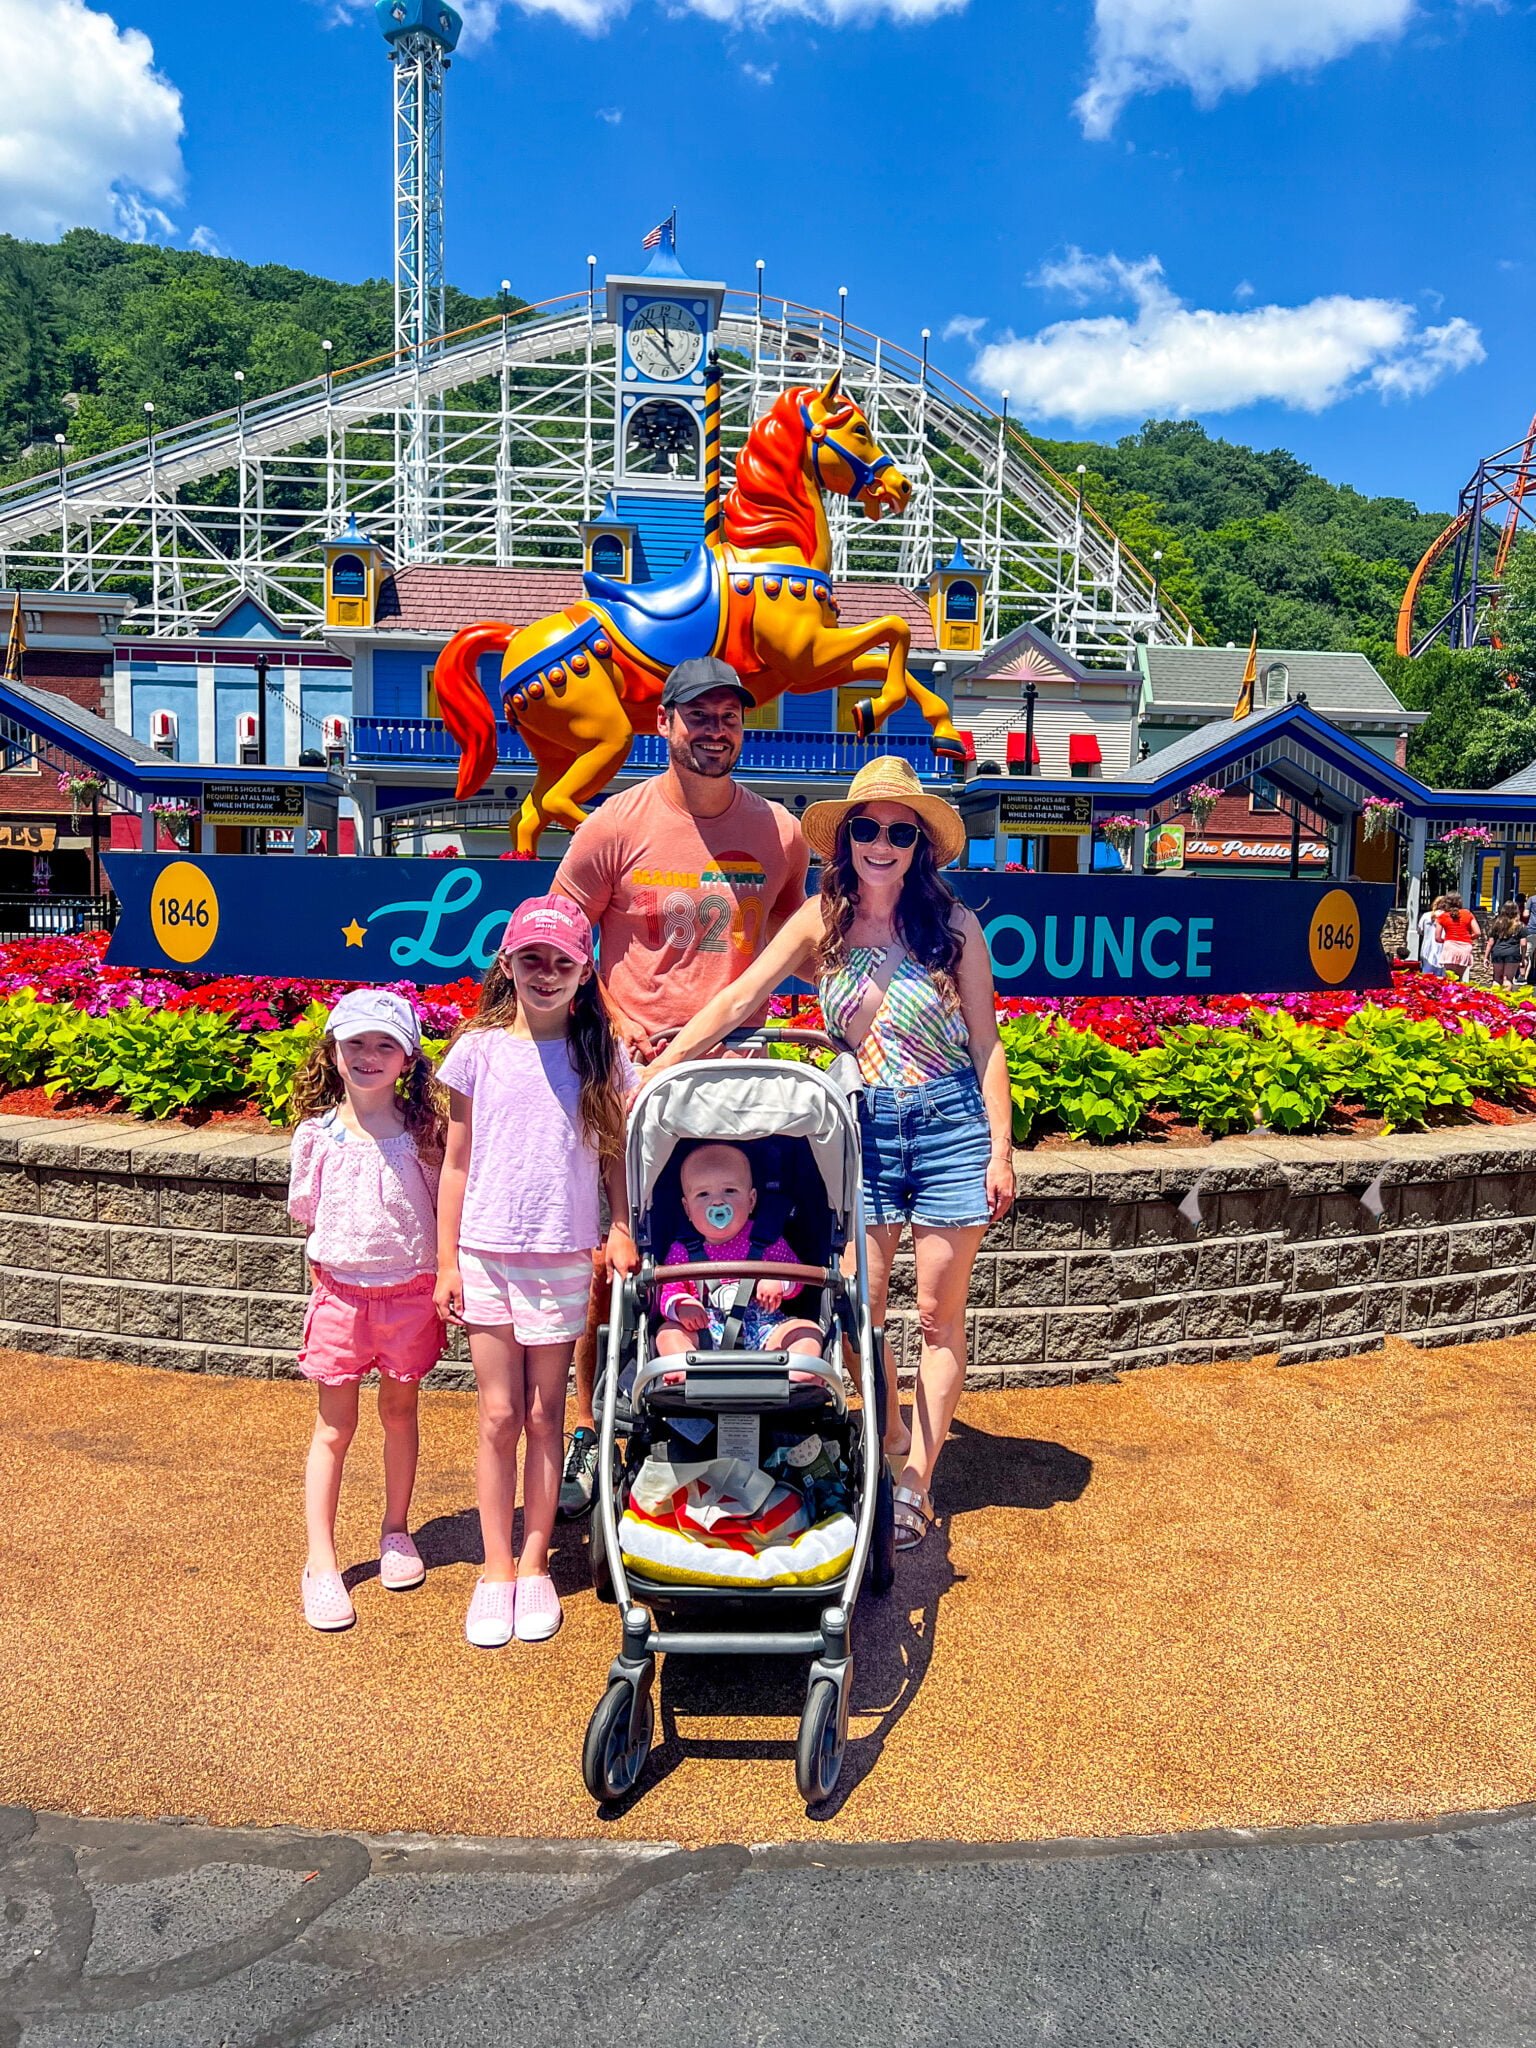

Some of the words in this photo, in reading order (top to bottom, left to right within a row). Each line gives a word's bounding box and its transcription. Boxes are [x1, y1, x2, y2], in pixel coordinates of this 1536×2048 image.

[646, 308, 654, 319] 11
[660, 305, 670, 316] 12
[678, 310, 682, 320] 1
[634, 320, 645, 330] 10
[688, 321, 695, 331] 2
[632, 335, 640, 346] 9
[692, 337, 700, 347] 3
[636, 351, 643, 361] 8
[689, 352, 696, 363] 4
[648, 363, 655, 373] 7
[662, 366, 669, 377] 6
[680, 364, 686, 373] 5
[266, 830, 294, 841] ERY
[1186, 841, 1218, 854] The
[1221, 840, 1291, 857] Potato
[632, 868, 700, 888] MAINE
[159, 898, 209, 927] 1846
[367, 867, 513, 968] La
[984, 914, 1214, 979] OUNCE
[632, 890, 763, 954] 1820
[1316, 924, 1354, 950] 1846
